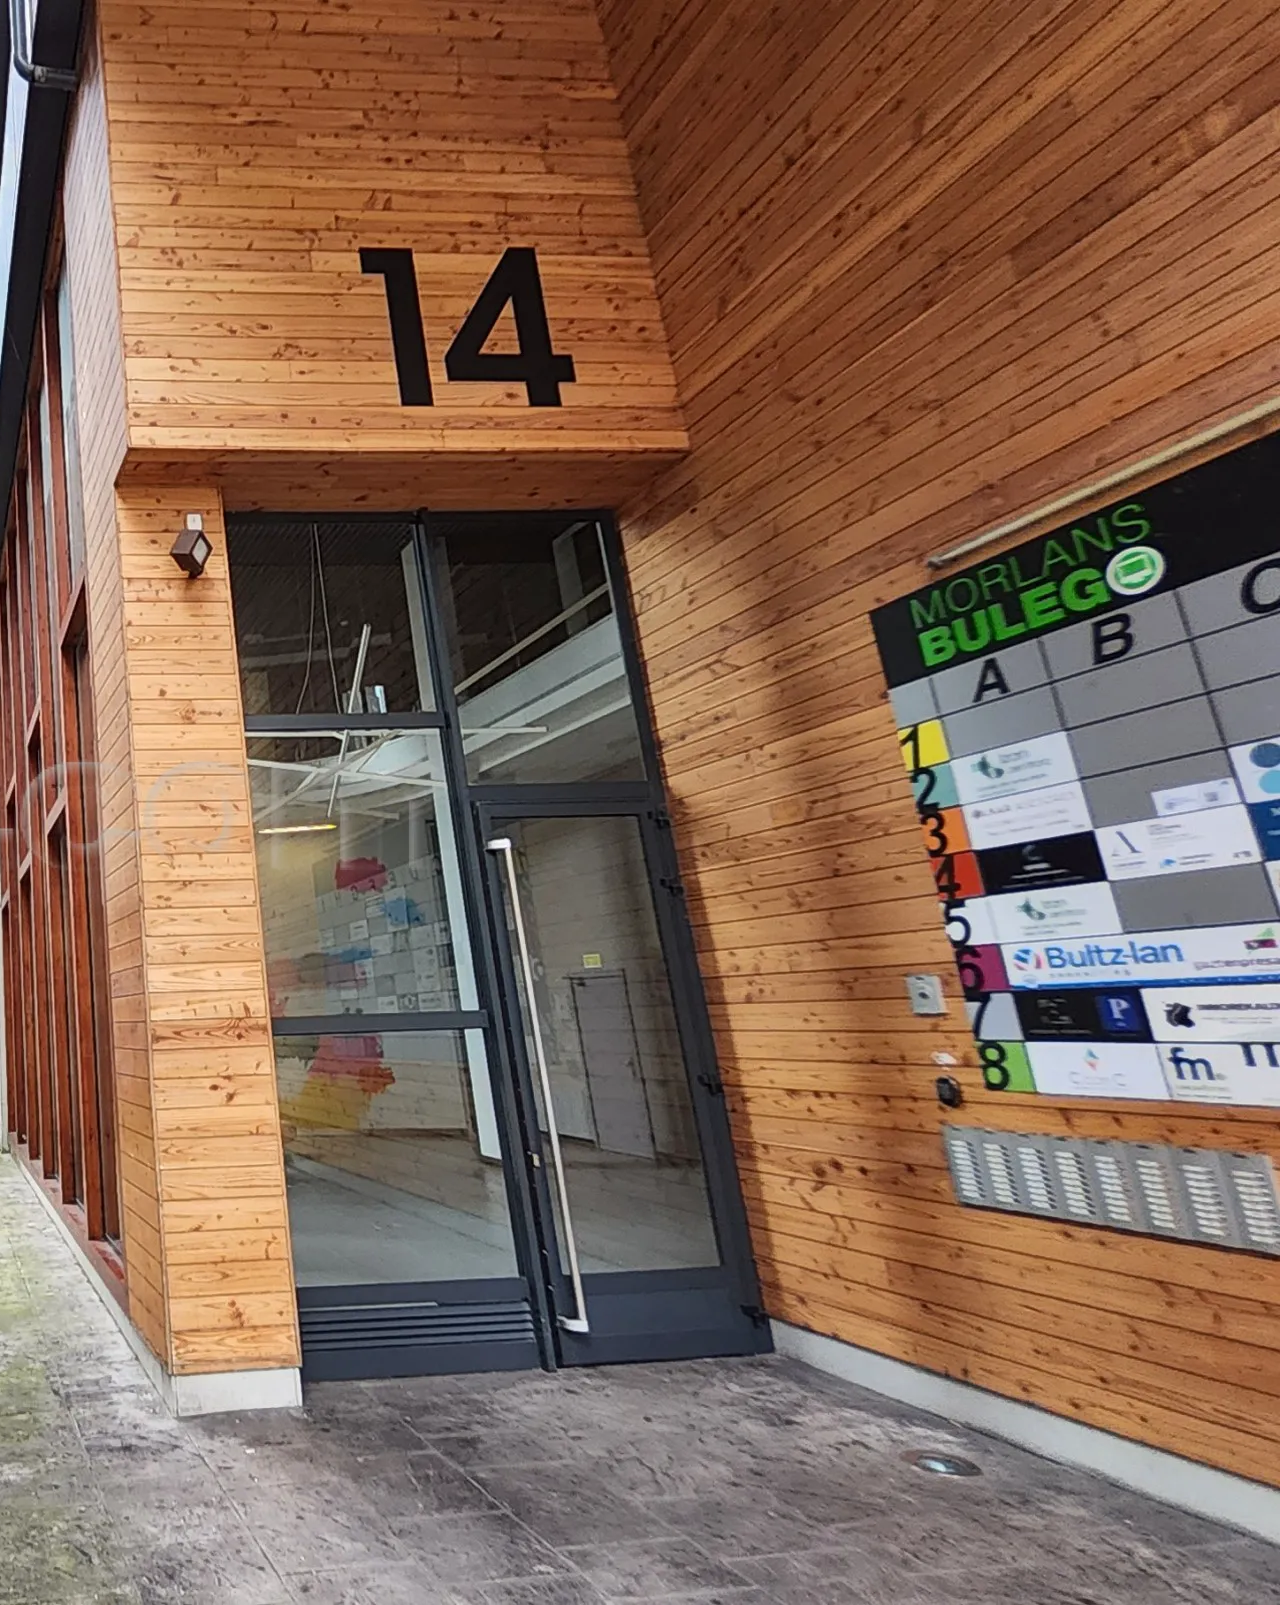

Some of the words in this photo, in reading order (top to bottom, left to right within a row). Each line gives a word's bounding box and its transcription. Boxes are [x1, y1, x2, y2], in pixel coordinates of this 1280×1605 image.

[358, 247, 576, 407] 14
[910, 503, 1151, 628] MORLANS
[972, 657, 1011, 703] A
[1092, 612, 1135, 665] B
[899, 725, 920, 770] 1
[911, 766, 939, 813] 2
[920, 811, 946, 857] 3
[935, 854, 961, 900] 4
[943, 898, 971, 947] 5
[956, 945, 984, 994] 6
[966, 991, 991, 1041] 7
[979, 1041, 1010, 1091] 8
